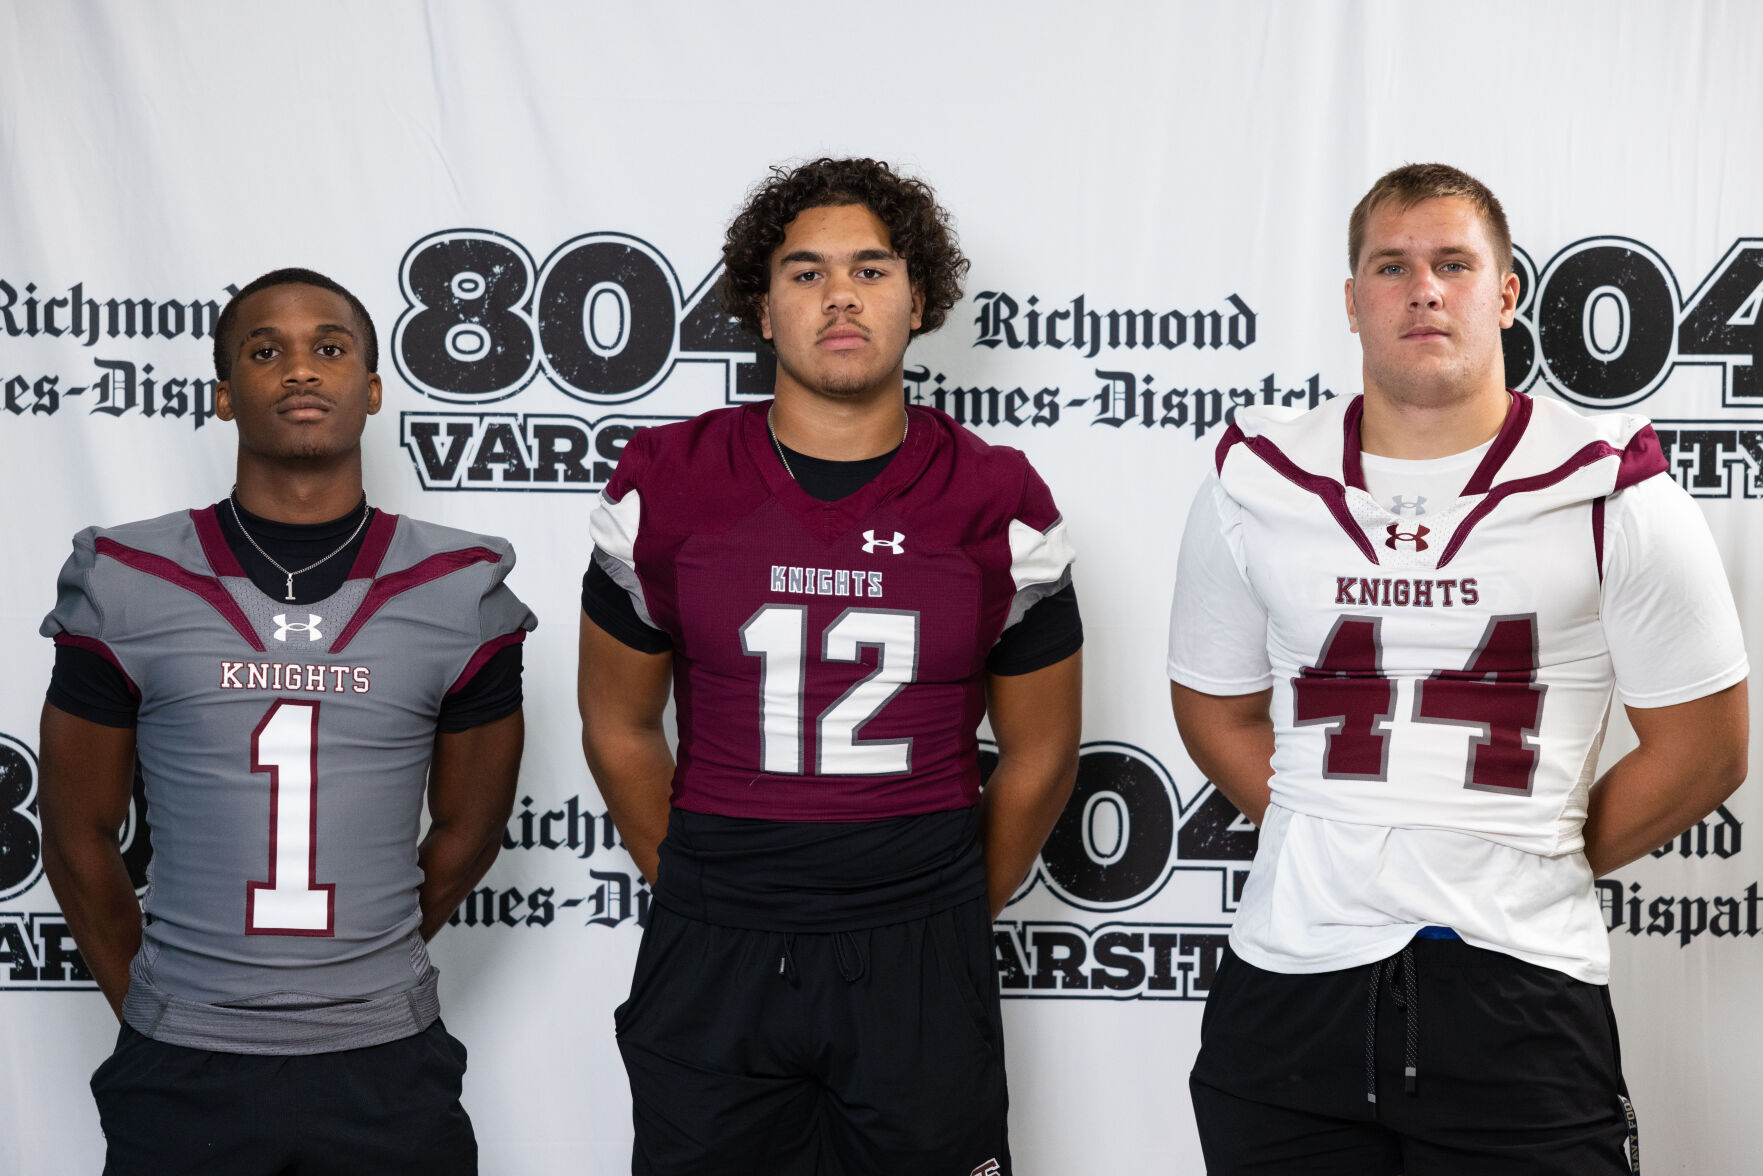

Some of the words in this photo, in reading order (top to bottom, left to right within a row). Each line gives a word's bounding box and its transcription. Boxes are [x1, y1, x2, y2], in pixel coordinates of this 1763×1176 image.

[0, 279, 240, 347] ichmon
[972, 290, 1258, 358] Richmond
[1502, 235, 1763, 409] 04
[0, 356, 217, 431] es-Disp
[770, 565, 883, 597] KNIGHTS
[1334, 576, 1480, 607] KNIGHTS
[220, 661, 370, 693] KNIGHTS
[739, 603, 920, 776] 12
[1290, 612, 1549, 798] 44
[245, 698, 336, 937] 1
[1629, 1134, 1640, 1172] NAVY
